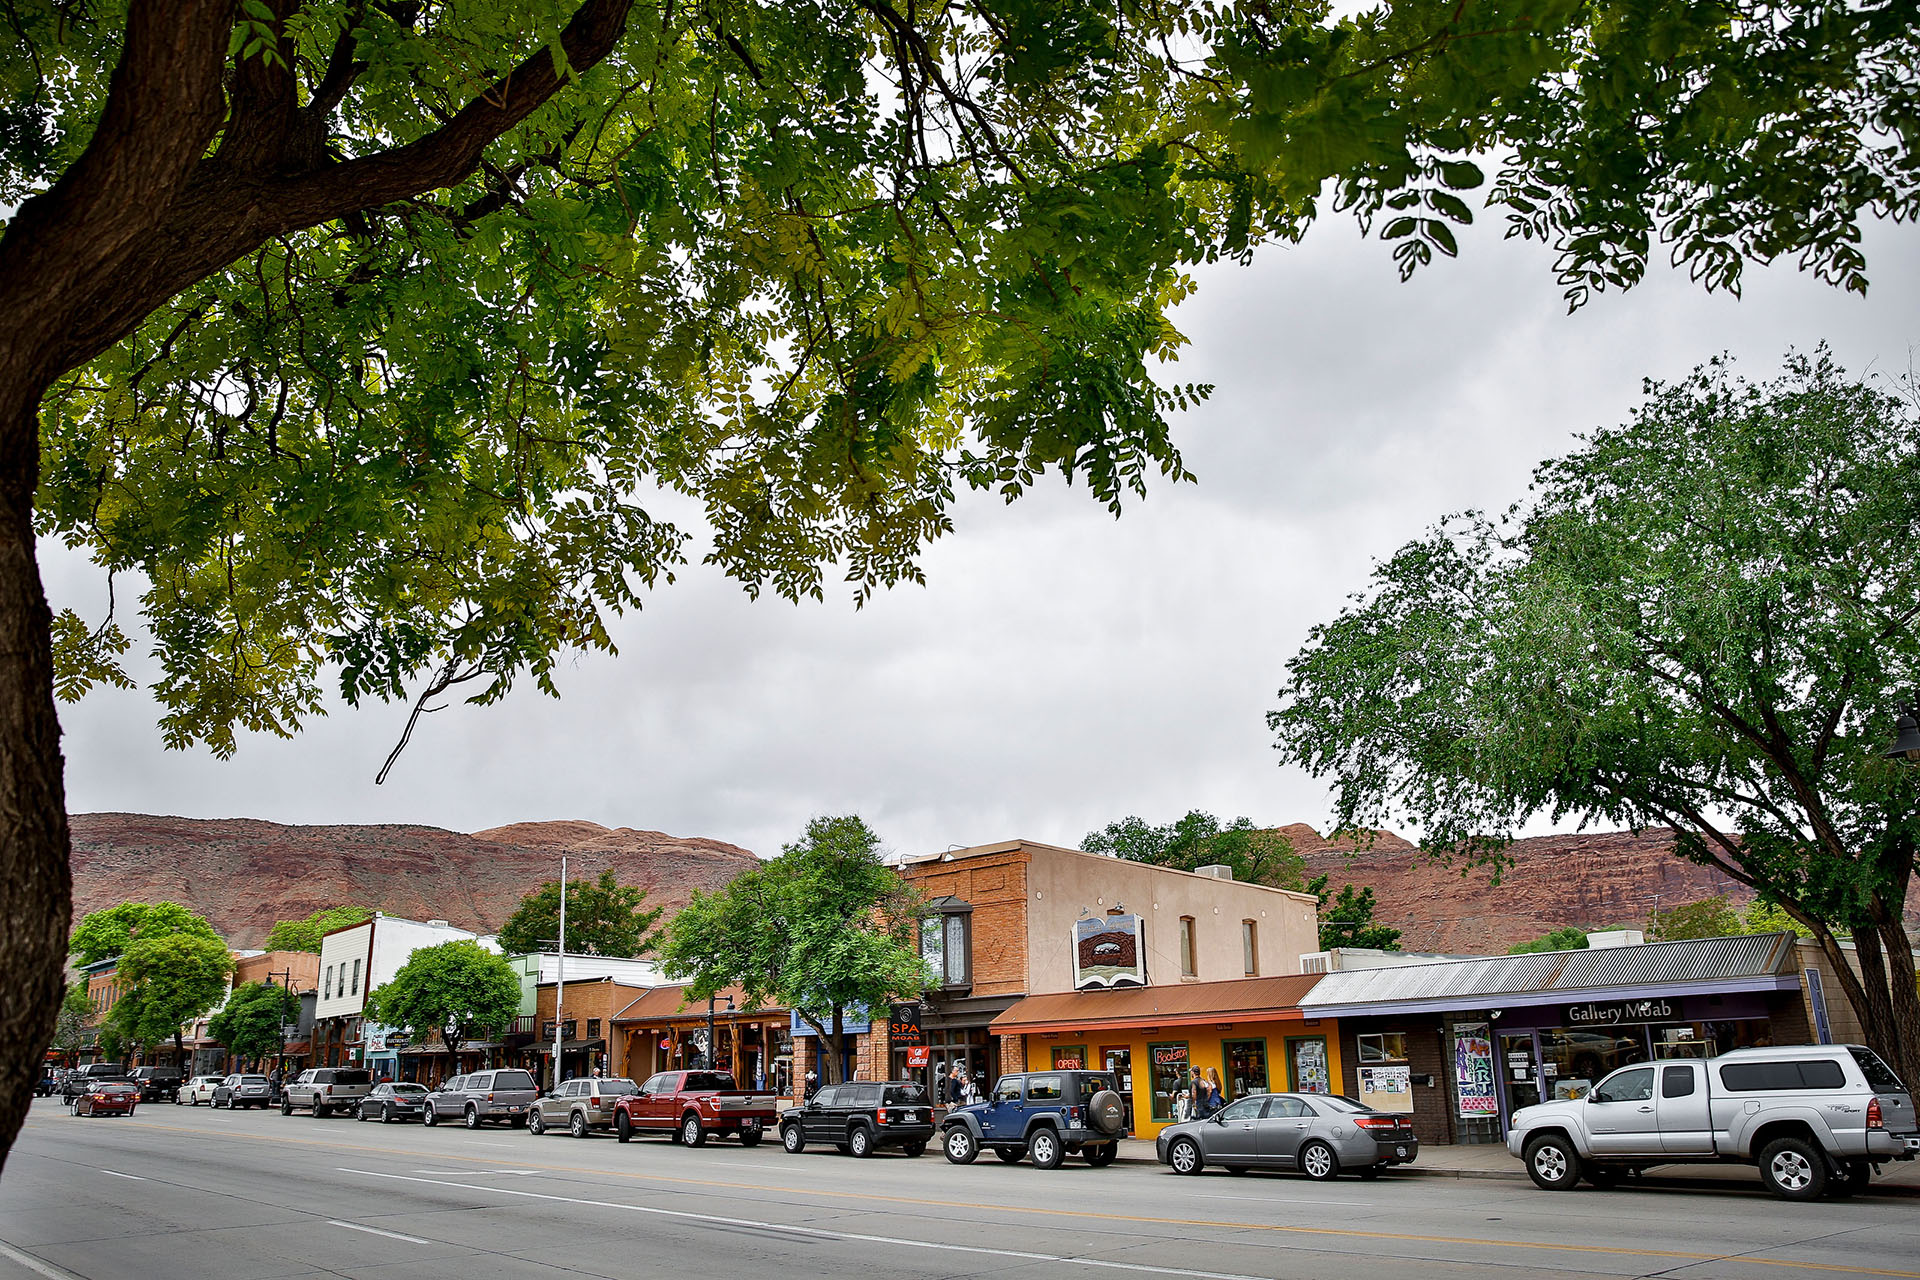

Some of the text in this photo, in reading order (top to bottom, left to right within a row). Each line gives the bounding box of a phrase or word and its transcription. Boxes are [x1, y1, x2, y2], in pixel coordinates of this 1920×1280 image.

[1569, 1003, 1622, 1025] Gallery
[892, 1023, 920, 1033] SPA
[1058, 1059, 1080, 1069] OPEN
[1156, 1049, 1187, 1064] Bookstor
[1474, 1058, 1491, 1094] ART
